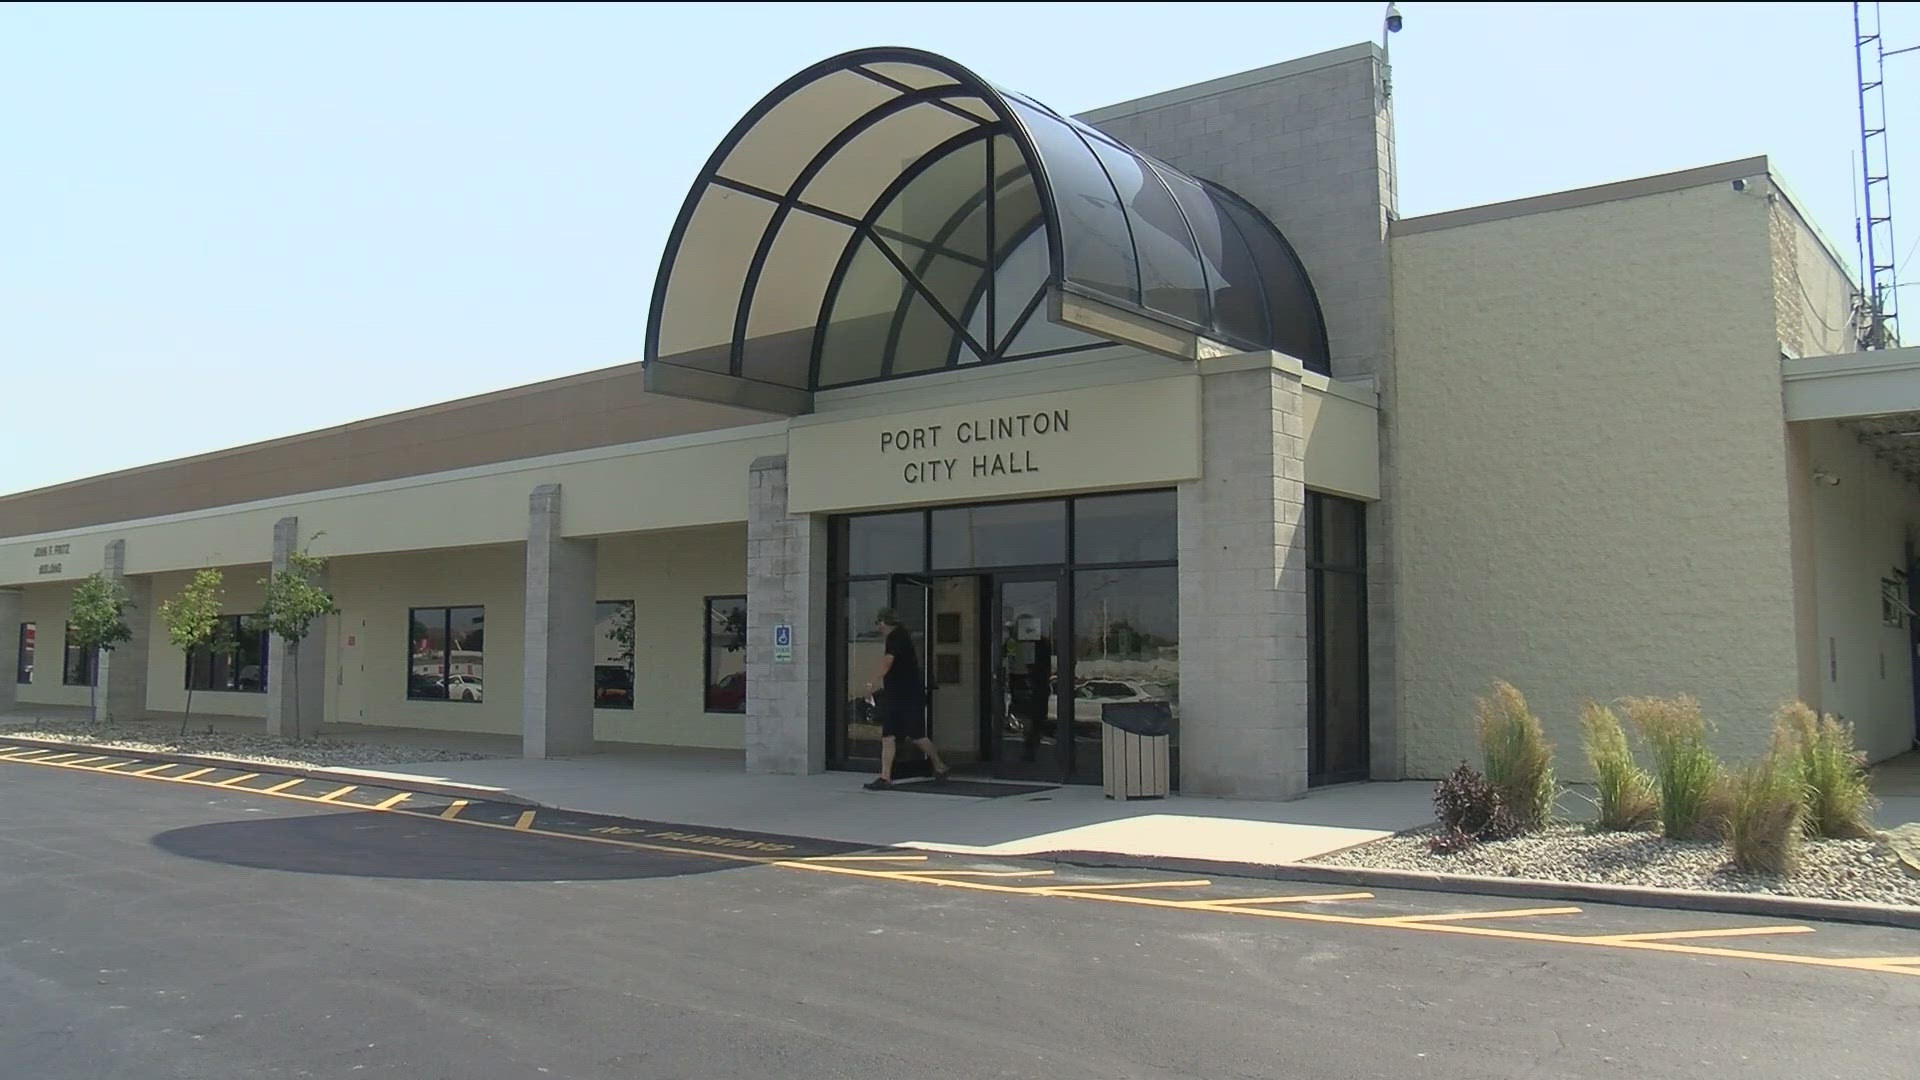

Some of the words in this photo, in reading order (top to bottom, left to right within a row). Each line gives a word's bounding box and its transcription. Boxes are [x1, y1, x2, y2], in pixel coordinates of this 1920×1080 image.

[881, 426, 941, 452] PORT
[957, 409, 1070, 443] CLINTON
[904, 458, 957, 483] CITY
[972, 451, 1039, 477] HALL
